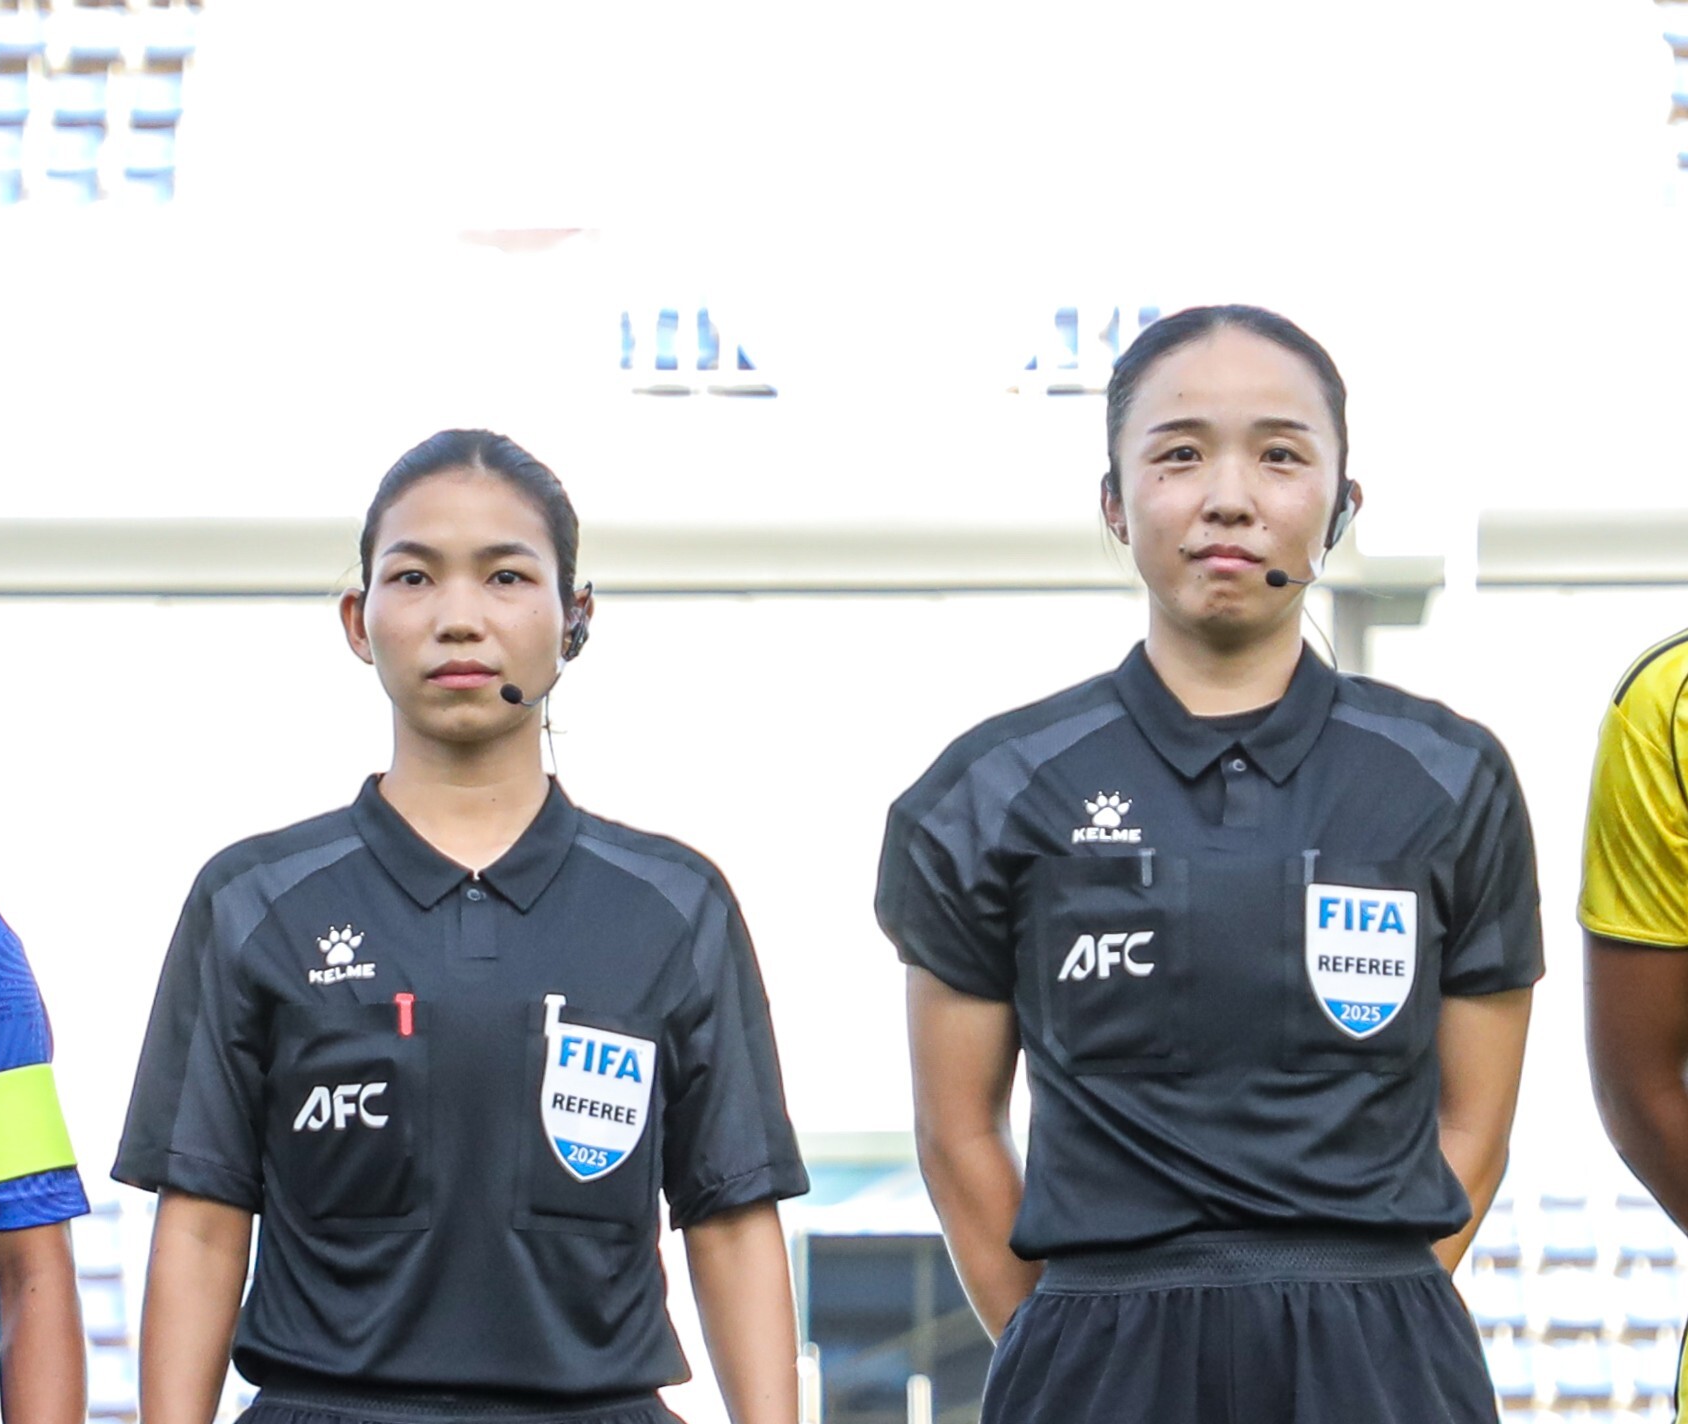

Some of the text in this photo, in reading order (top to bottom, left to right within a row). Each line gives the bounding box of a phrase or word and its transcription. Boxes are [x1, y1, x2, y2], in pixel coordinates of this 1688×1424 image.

[1072, 826, 1141, 843] KELME
[1318, 897, 1406, 935] FIFA
[1057, 931, 1155, 982] AFC
[1318, 955, 1406, 977] REFEREE
[309, 962, 376, 985] KELME
[1340, 1003, 1382, 1022] 2025
[558, 1035, 643, 1084] FIFA
[293, 1082, 390, 1132] AFC
[551, 1093, 638, 1126] REFEREE
[567, 1143, 609, 1167] 2025
